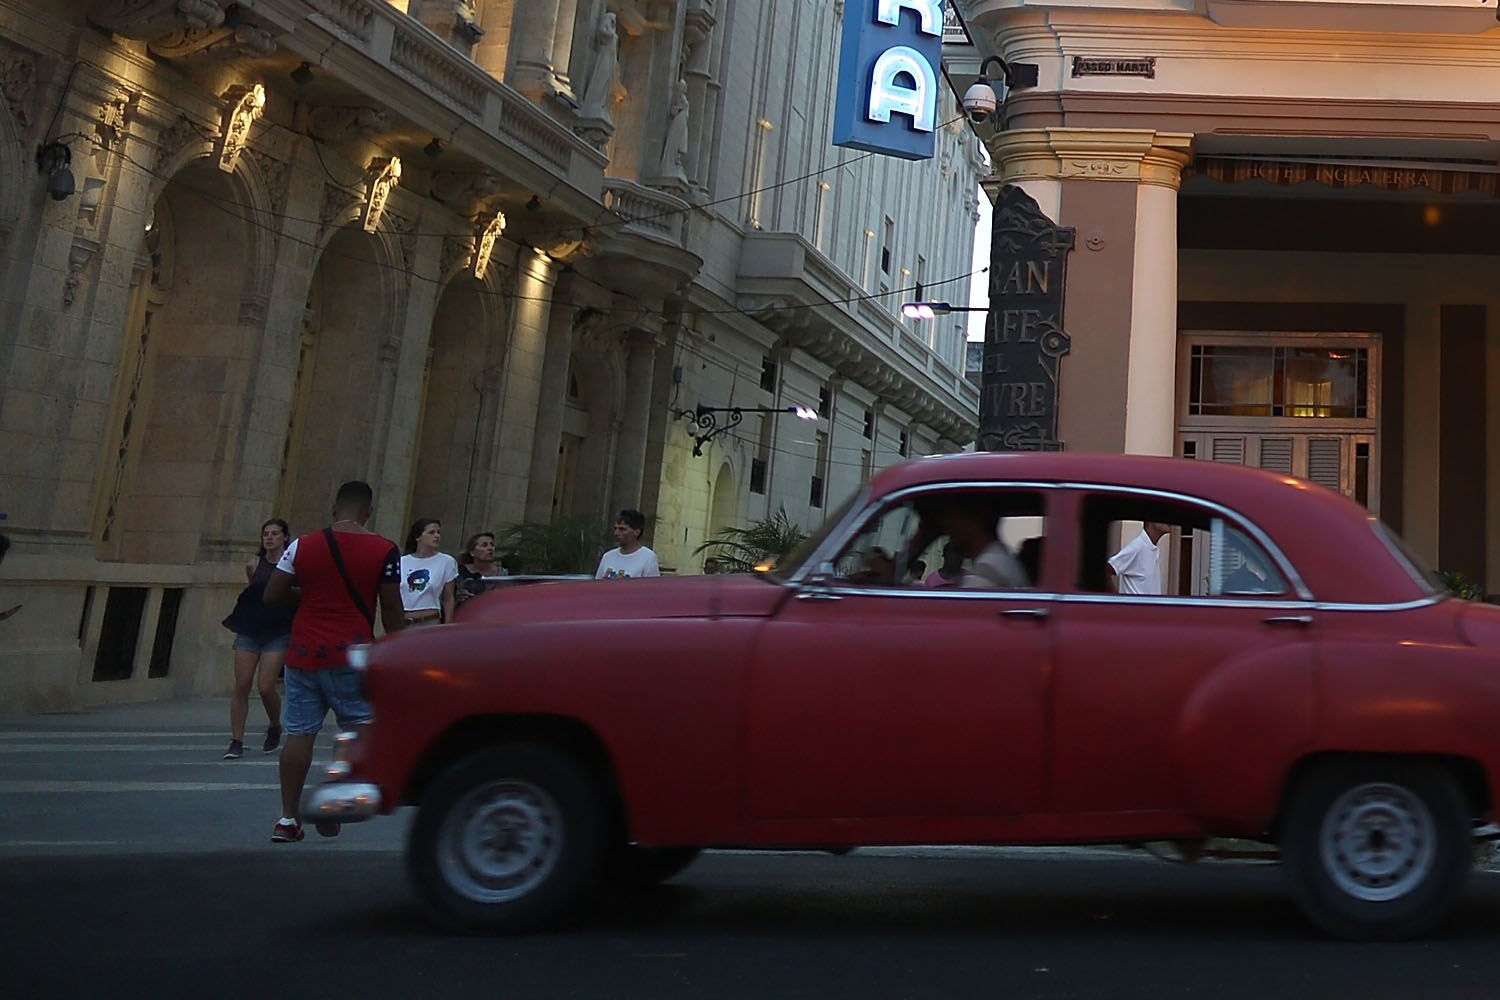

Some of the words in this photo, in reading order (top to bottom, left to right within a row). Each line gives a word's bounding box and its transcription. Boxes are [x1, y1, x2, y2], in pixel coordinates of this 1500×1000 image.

[1079, 62, 1111, 72] PASEO
[1247, 166, 1306, 181] HOTEL
[1315, 167, 1429, 186] INGLATERRA
[990, 260, 1052, 295] RAN
[987, 309, 1040, 343] AFE
